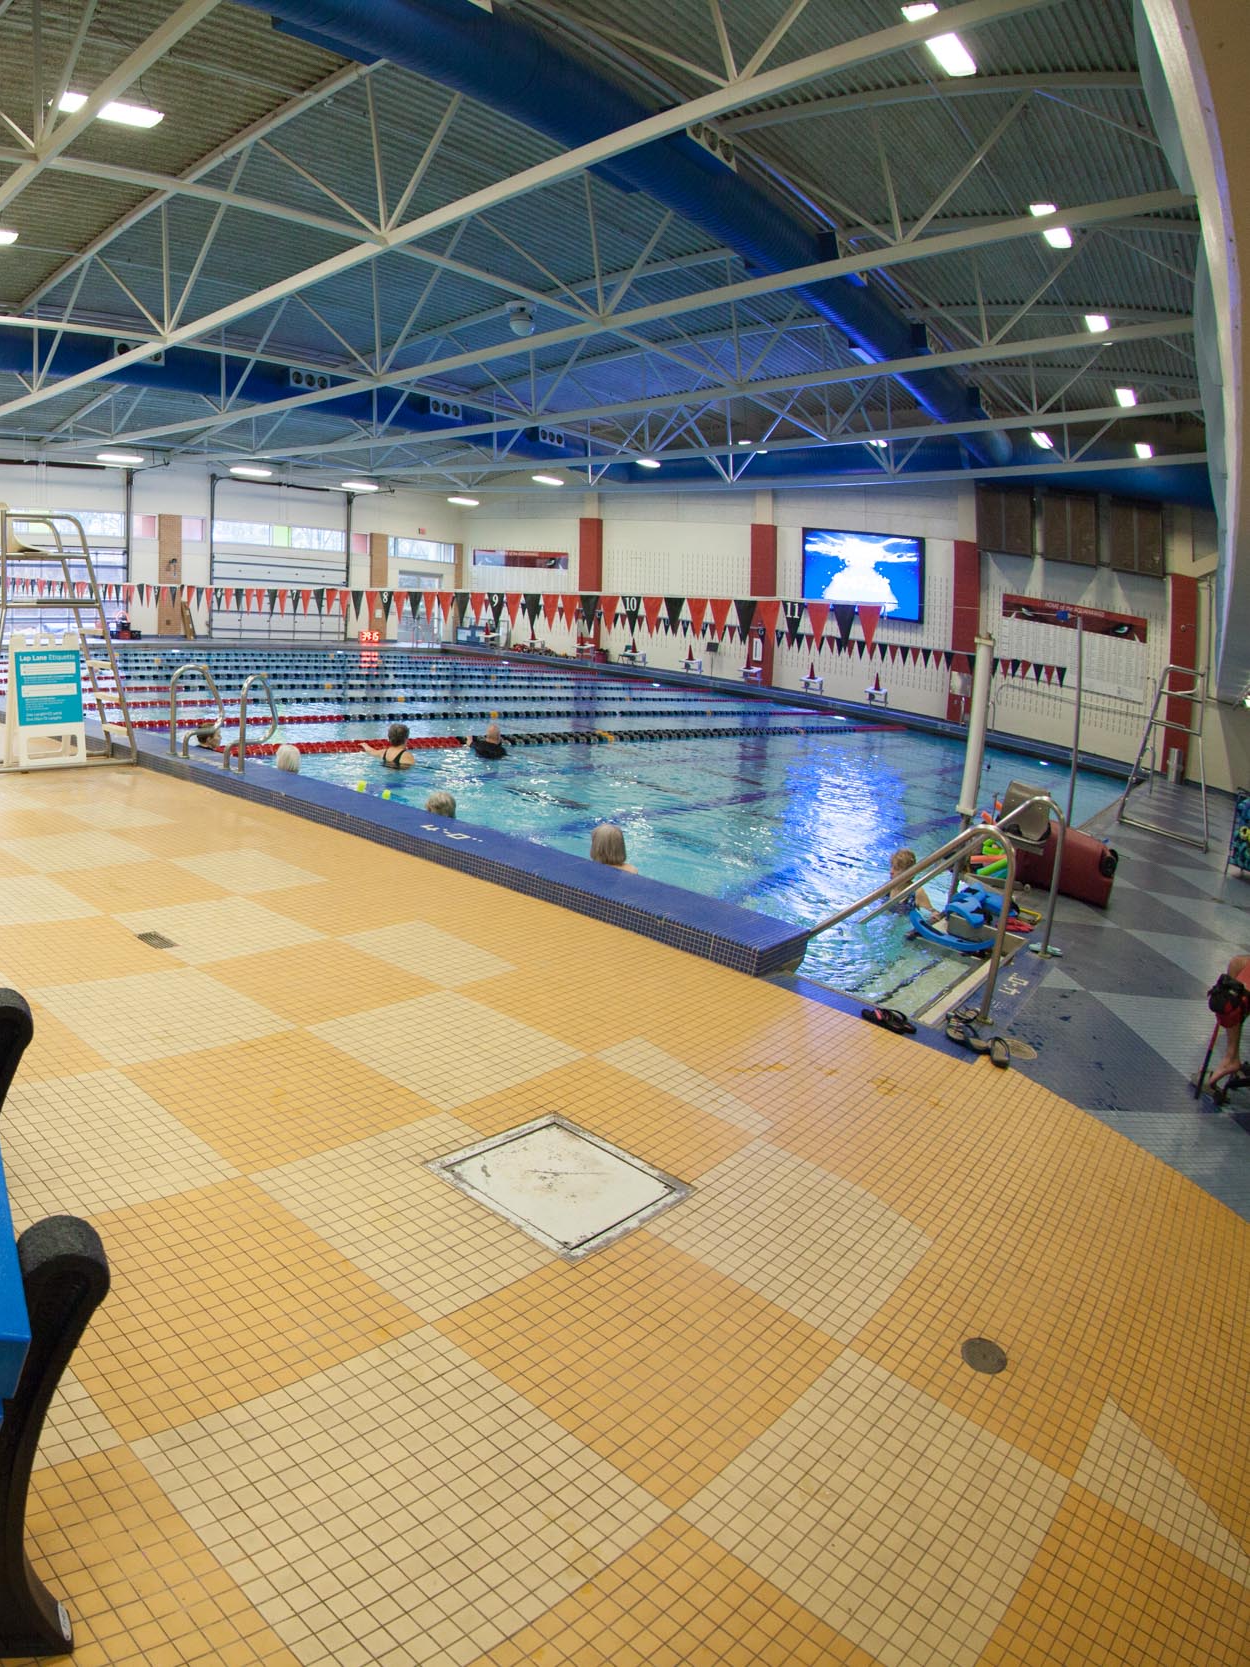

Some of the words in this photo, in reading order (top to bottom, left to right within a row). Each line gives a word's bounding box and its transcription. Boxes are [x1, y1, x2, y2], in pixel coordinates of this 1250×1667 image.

[382, 591, 388, 603] 8
[492, 594, 499, 607] 9
[625, 597, 637, 611] 10
[786, 602, 800, 619] 11
[361, 631, 379, 641] 39:15
